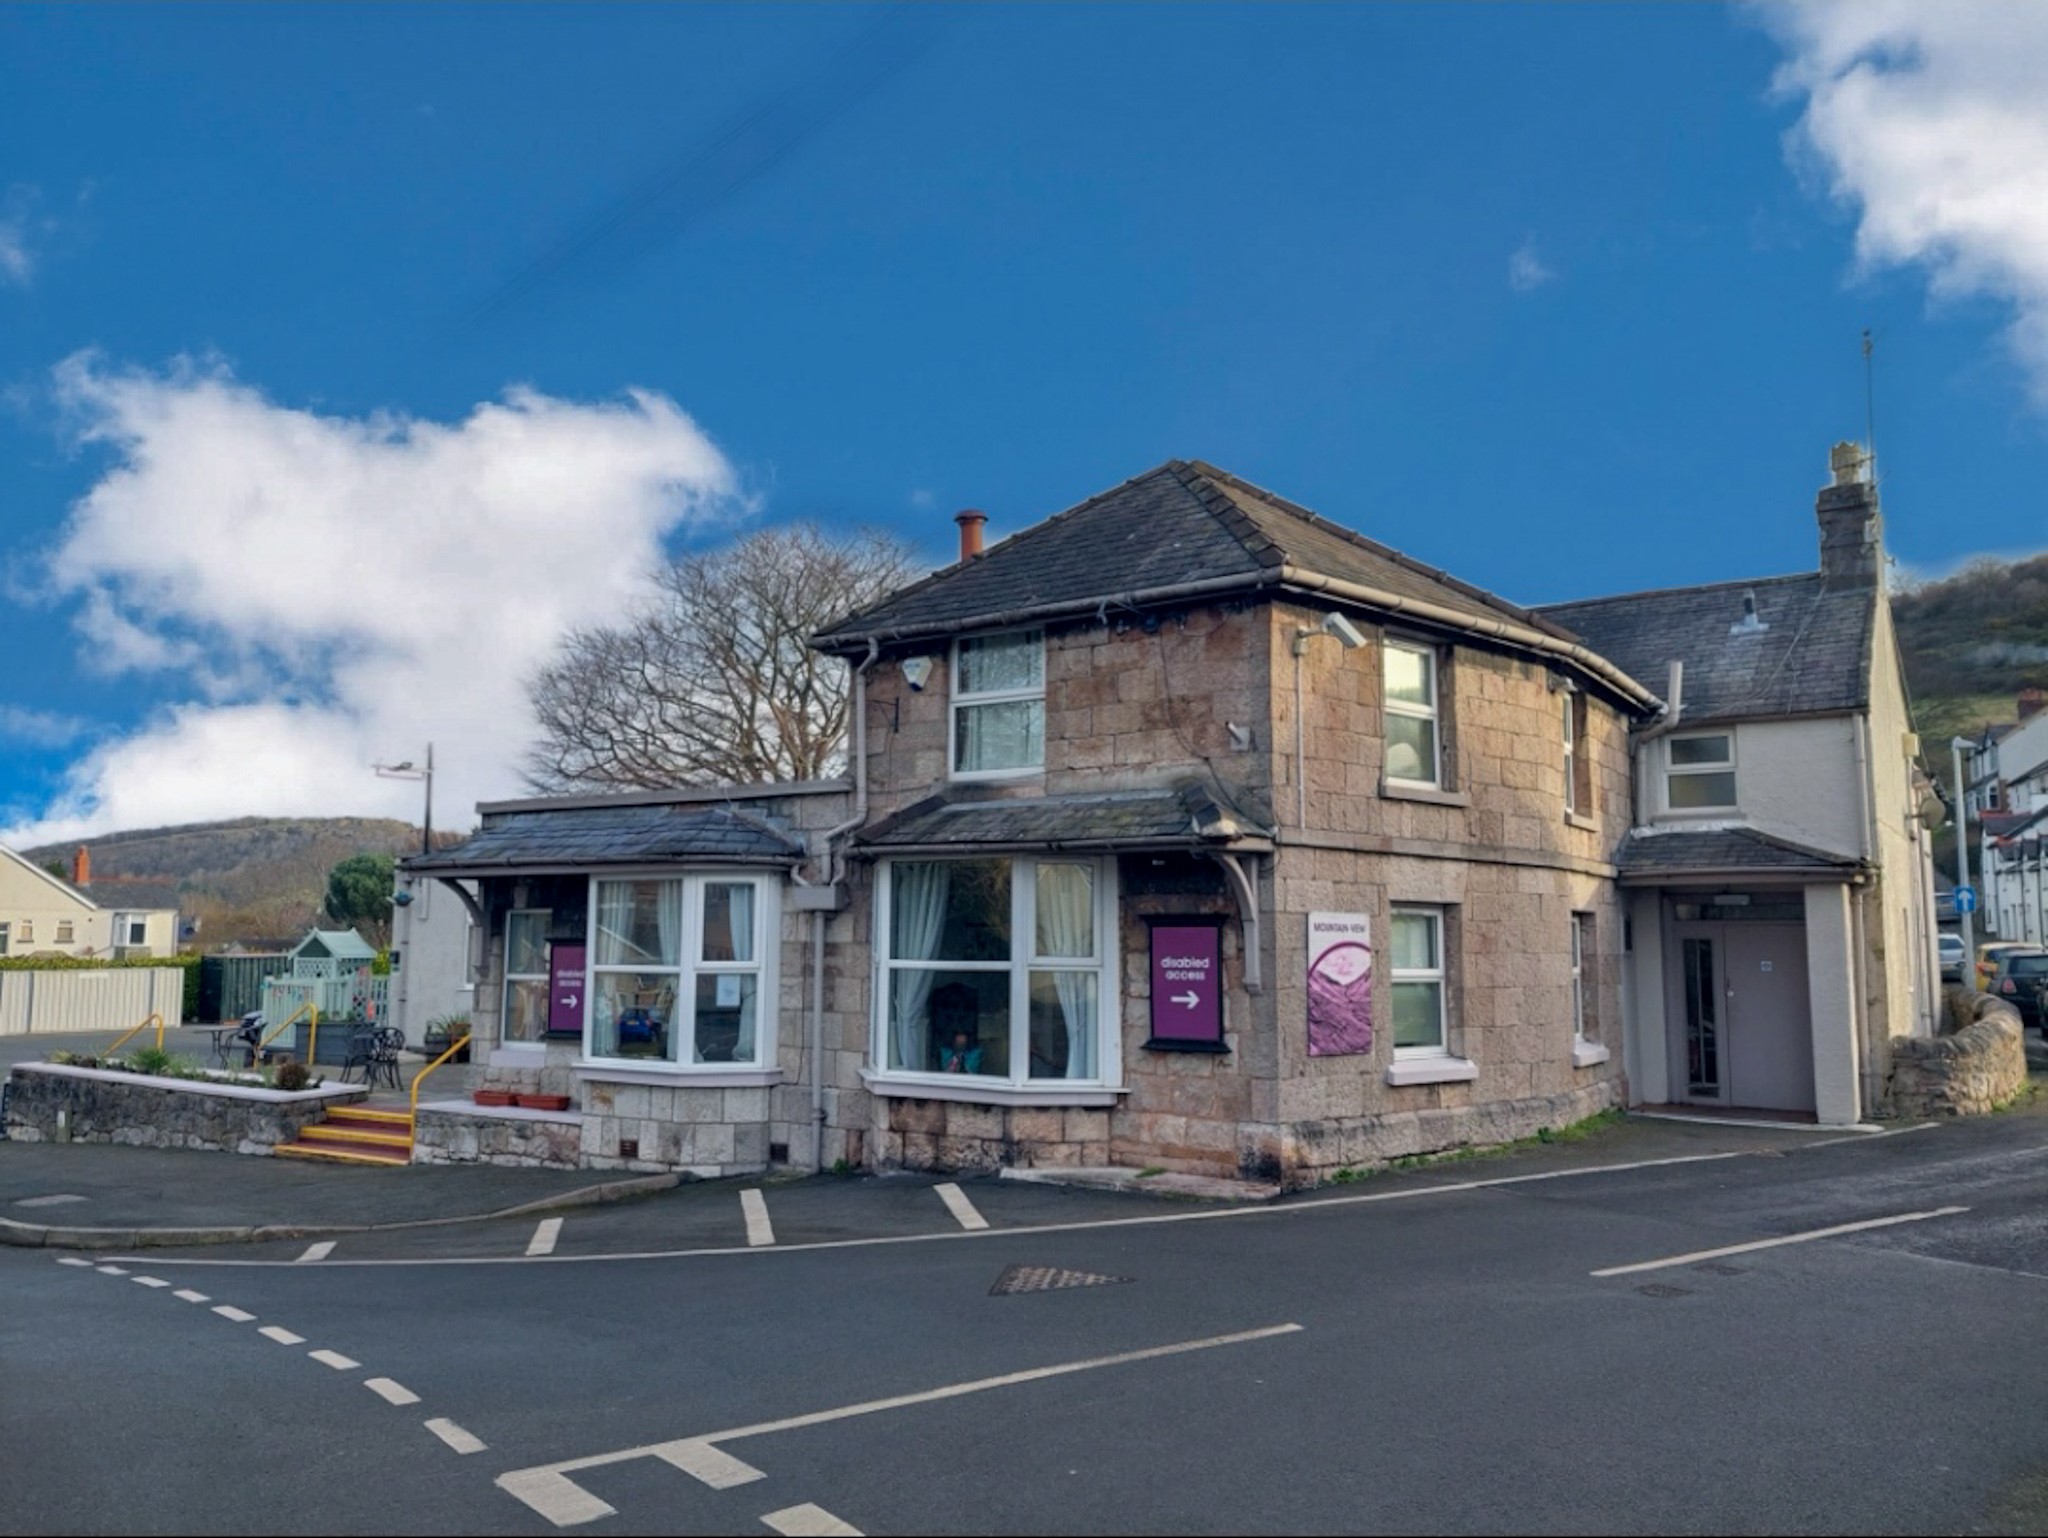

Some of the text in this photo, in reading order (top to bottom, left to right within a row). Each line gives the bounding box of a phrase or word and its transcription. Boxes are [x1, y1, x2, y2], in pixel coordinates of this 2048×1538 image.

[1313, 922, 1349, 932] MOUNTAIN
[1161, 956, 1210, 969] disabled
[1165, 970, 1206, 981] access
